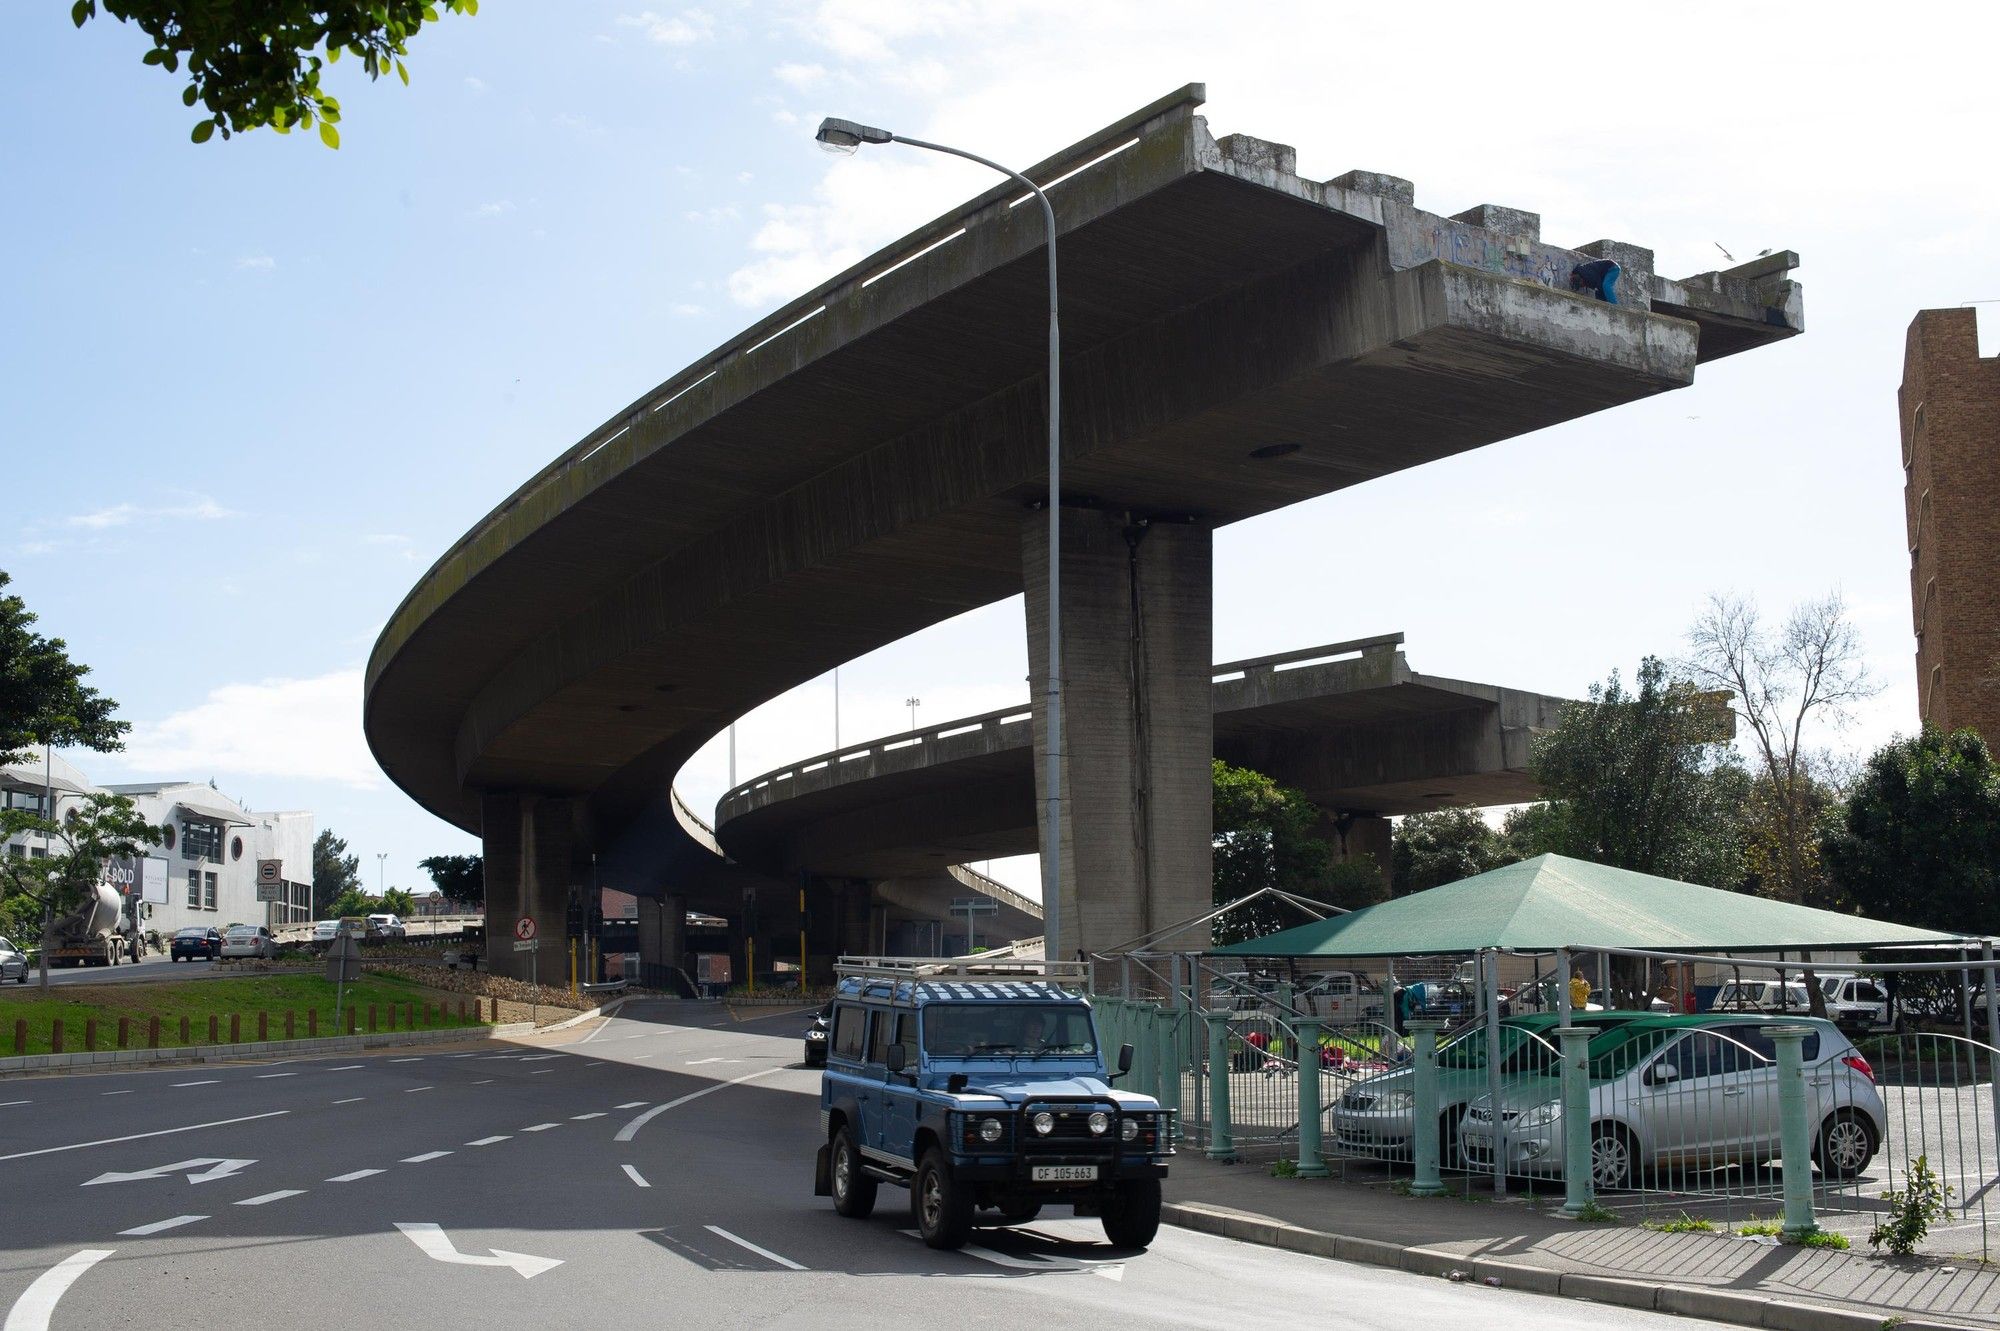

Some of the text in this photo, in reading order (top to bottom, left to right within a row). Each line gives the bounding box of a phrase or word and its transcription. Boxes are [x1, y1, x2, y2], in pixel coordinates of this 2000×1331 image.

[112, 866, 134, 883] BOLD
[1038, 1167, 1092, 1179] CF 105-663
